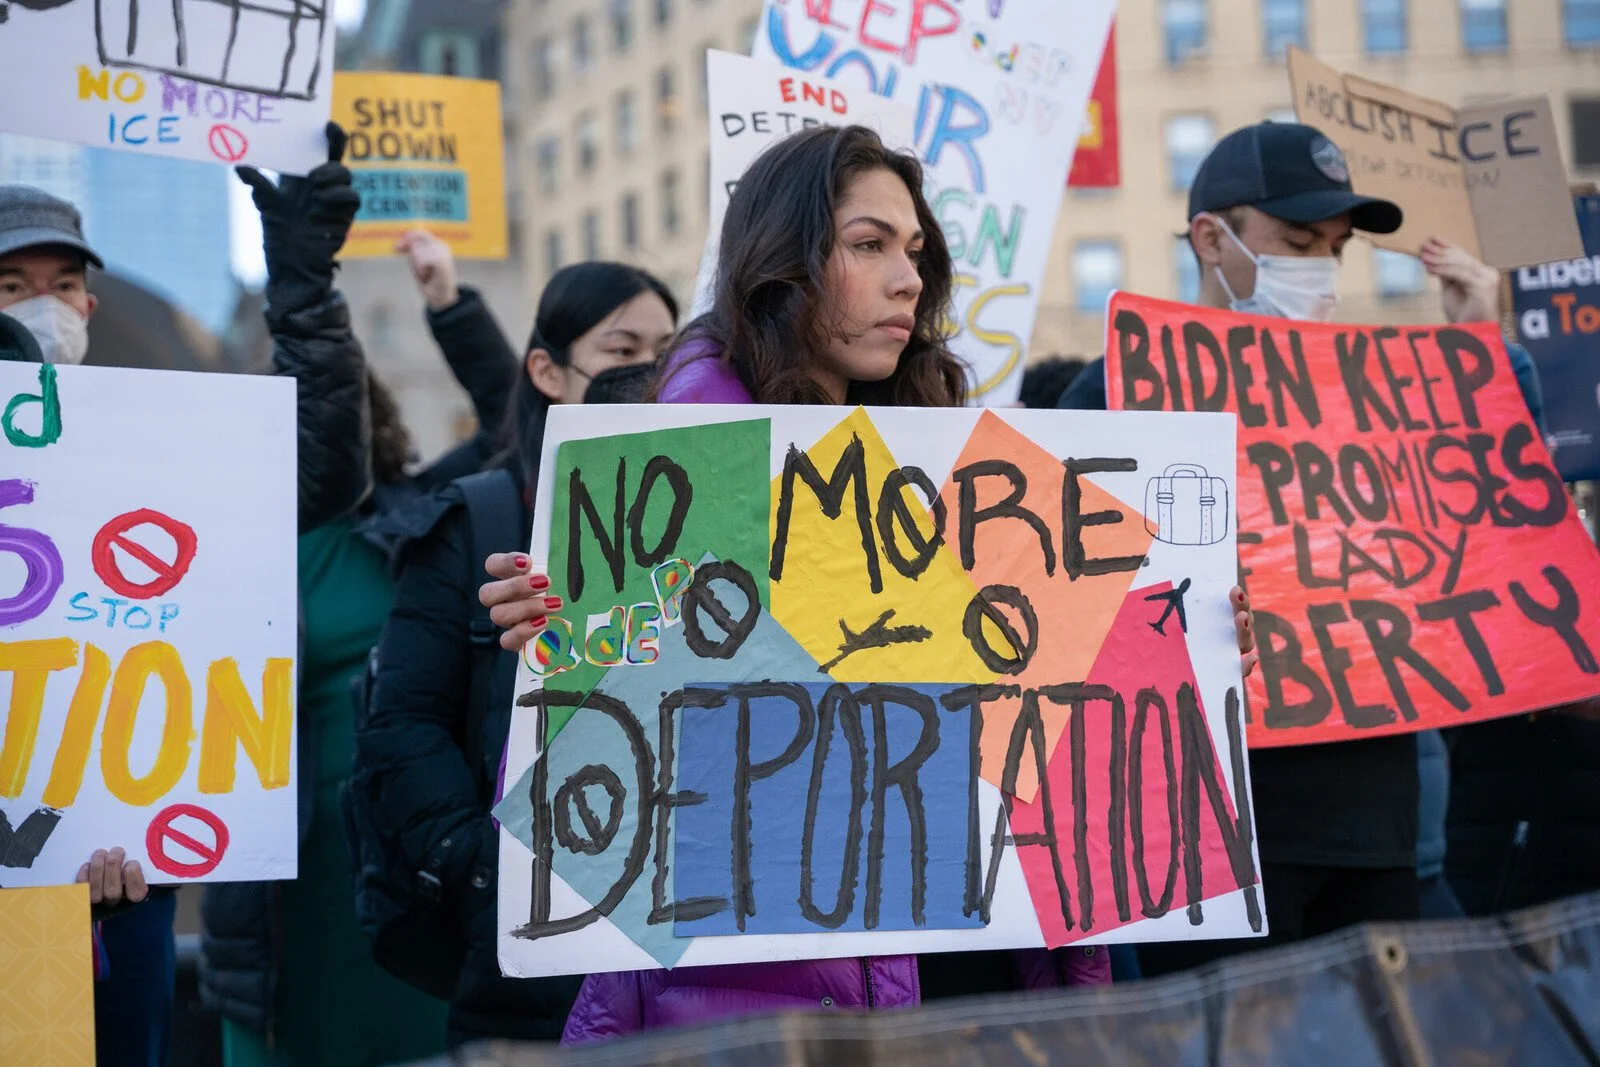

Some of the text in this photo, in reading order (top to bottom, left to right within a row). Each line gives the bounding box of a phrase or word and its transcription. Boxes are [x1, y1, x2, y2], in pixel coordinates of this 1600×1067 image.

[76, 65, 281, 122] NO MORE
[353, 97, 446, 128] SHUT
[779, 77, 848, 114] END
[1305, 80, 1414, 143] ABOLISH
[1425, 110, 1541, 162] ICE
[108, 112, 181, 144] ICE
[348, 130, 457, 162] DOWN
[1521, 308, 1550, 340] a
[1115, 309, 1495, 434] BIDEN KEEP
[1247, 422, 1568, 527] PROMISES
[567, 457, 694, 602] NO
[768, 431, 1149, 596] MORE
[1293, 517, 1468, 596] LADY
[65, 591, 181, 633] STOP
[510, 680, 1263, 938] DEPORTATION
